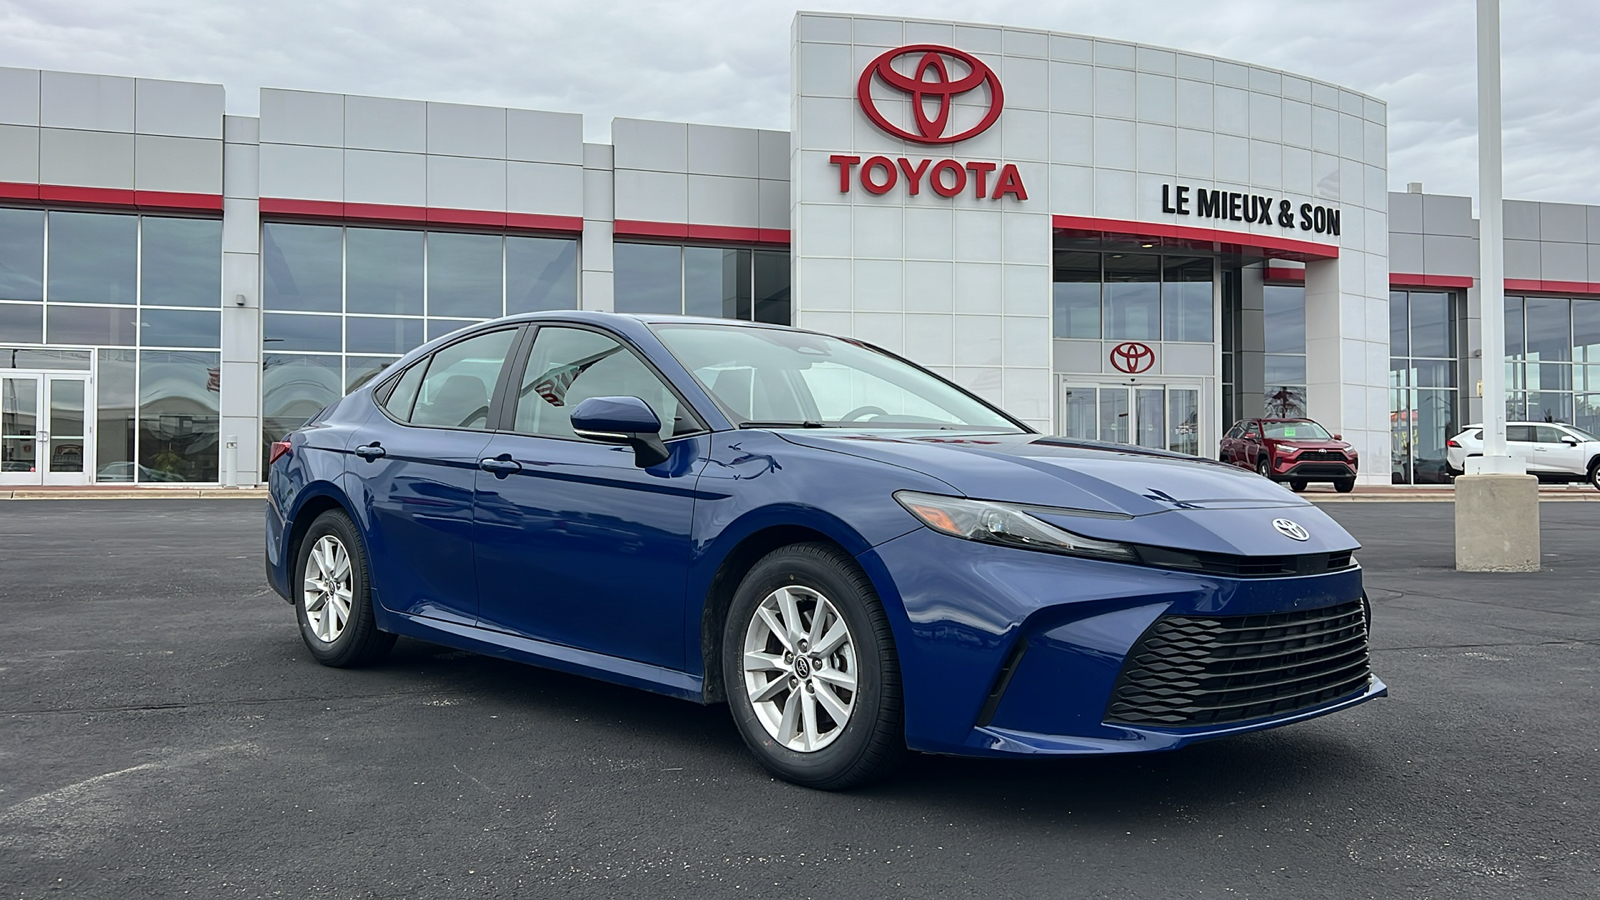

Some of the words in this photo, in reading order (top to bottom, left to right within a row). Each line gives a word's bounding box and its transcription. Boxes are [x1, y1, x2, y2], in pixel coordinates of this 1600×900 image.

[829, 155, 1028, 200] TOYOTA
[1163, 184, 1190, 215] LE
[1197, 188, 1273, 225] MIEUX
[1278, 199, 1295, 229] &
[1300, 203, 1341, 236] SON
